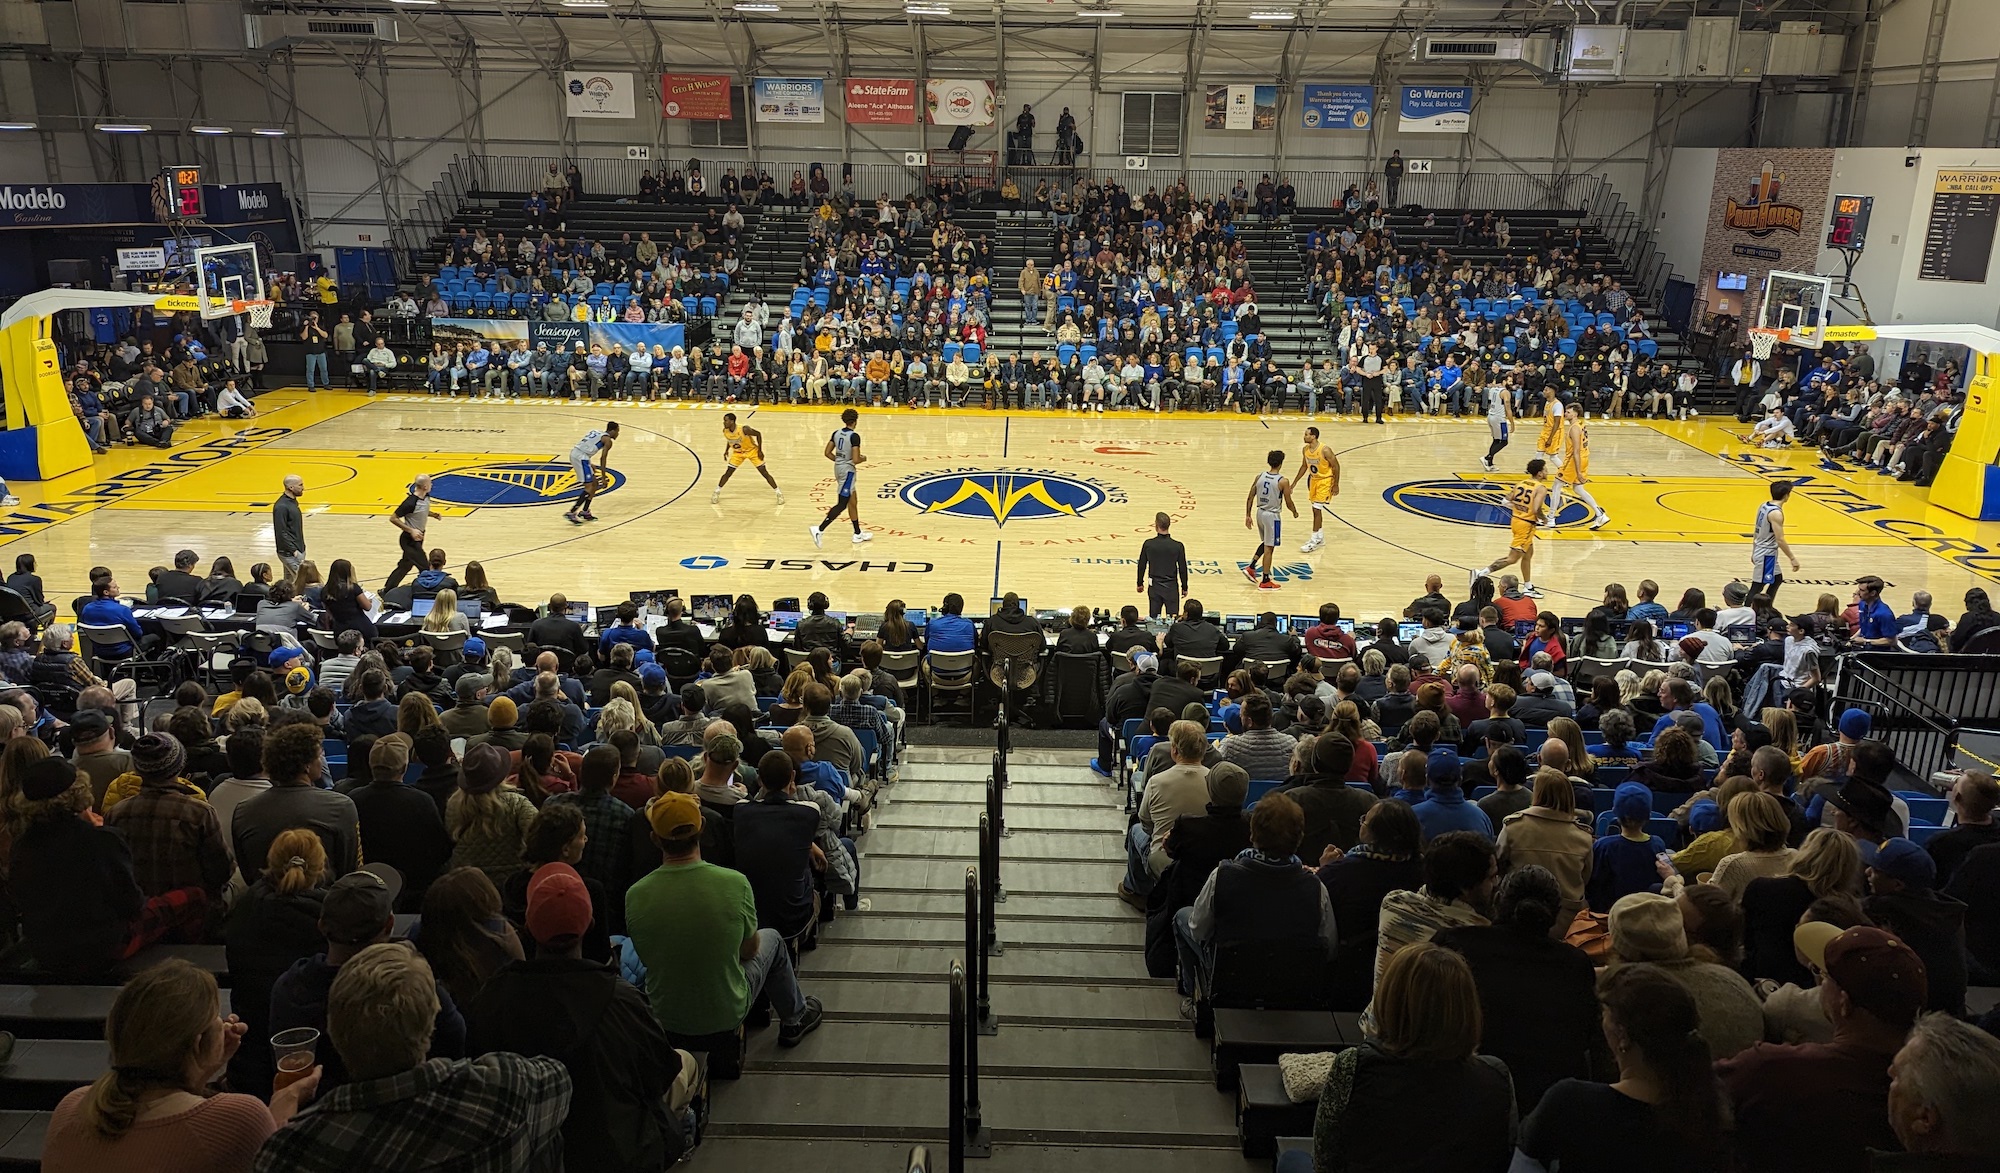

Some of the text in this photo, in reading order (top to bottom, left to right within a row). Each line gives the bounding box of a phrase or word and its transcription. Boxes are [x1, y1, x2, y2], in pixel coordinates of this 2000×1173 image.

[1410, 89, 1464, 99] Go Warriors!
[639, 149, 647, 158] H
[1139, 159, 1144, 167] J
[1421, 162, 1428, 170] K
[178, 170, 198, 184] 10:27
[0, 186, 66, 210] Modelo
[181, 189, 198, 215] 22
[238, 190, 268, 210] Modelo
[1839, 200, 1861, 212] 10:27
[14, 212, 52, 222] Cantina
[1832, 218, 1854, 243] 22
[534, 323, 581, 345] Seascape
[39, 370, 60, 378] DOORDASH
[838, 438, 844, 450] 0
[994, 467, 1077, 477] CRUZ
[0, 428, 292, 536] WARRIORS
[877, 467, 982, 499] WARRIORS
[1263, 482, 1270, 495] 5
[1719, 453, 1888, 514] SANTA
[1515, 486, 1532, 504] 25
[1020, 533, 1126, 546] SANTA
[740, 558, 934, 573] CHASE
